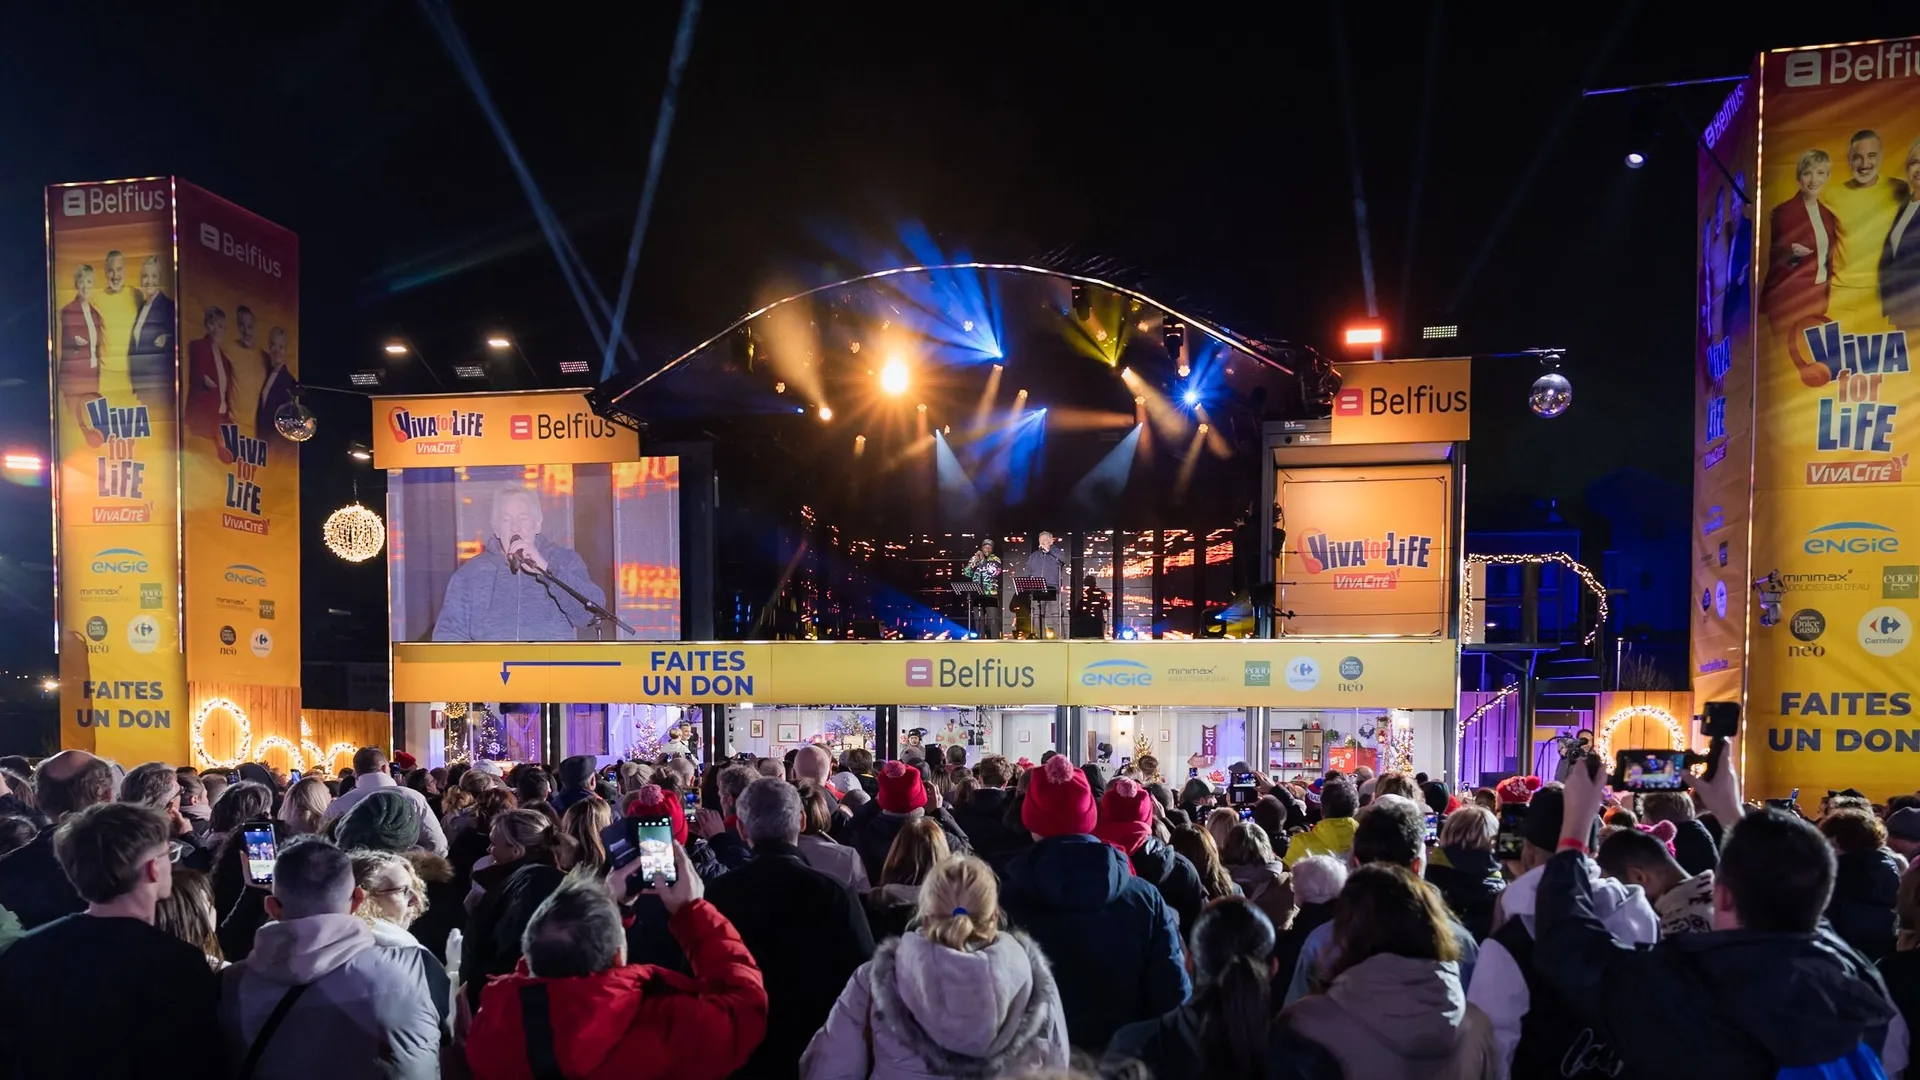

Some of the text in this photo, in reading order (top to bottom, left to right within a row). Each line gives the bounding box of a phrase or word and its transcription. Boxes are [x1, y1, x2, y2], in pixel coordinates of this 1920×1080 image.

[90, 185, 166, 215] Belfius
[223, 233, 282, 278] Belfius
[1837, 369, 1883, 403] for
[1371, 386, 1467, 416] Belfius
[436, 415, 454, 431] for
[538, 413, 617, 440] Belfius
[108, 434, 136, 460] for
[236, 457, 256, 481] for
[1364, 538, 1389, 561] for
[1864, 637, 1904, 645] Carrefour
[651, 650, 746, 671] FAITES
[939, 658, 1035, 688] Belfius
[83, 680, 164, 700] FAITES
[642, 675, 754, 696] UN DON
[1781, 692, 1912, 716] FAITES
[77, 709, 171, 729] UN DON
[1205, 729, 1215, 764] EXIT
[1769, 728, 1920, 752] UN DON
